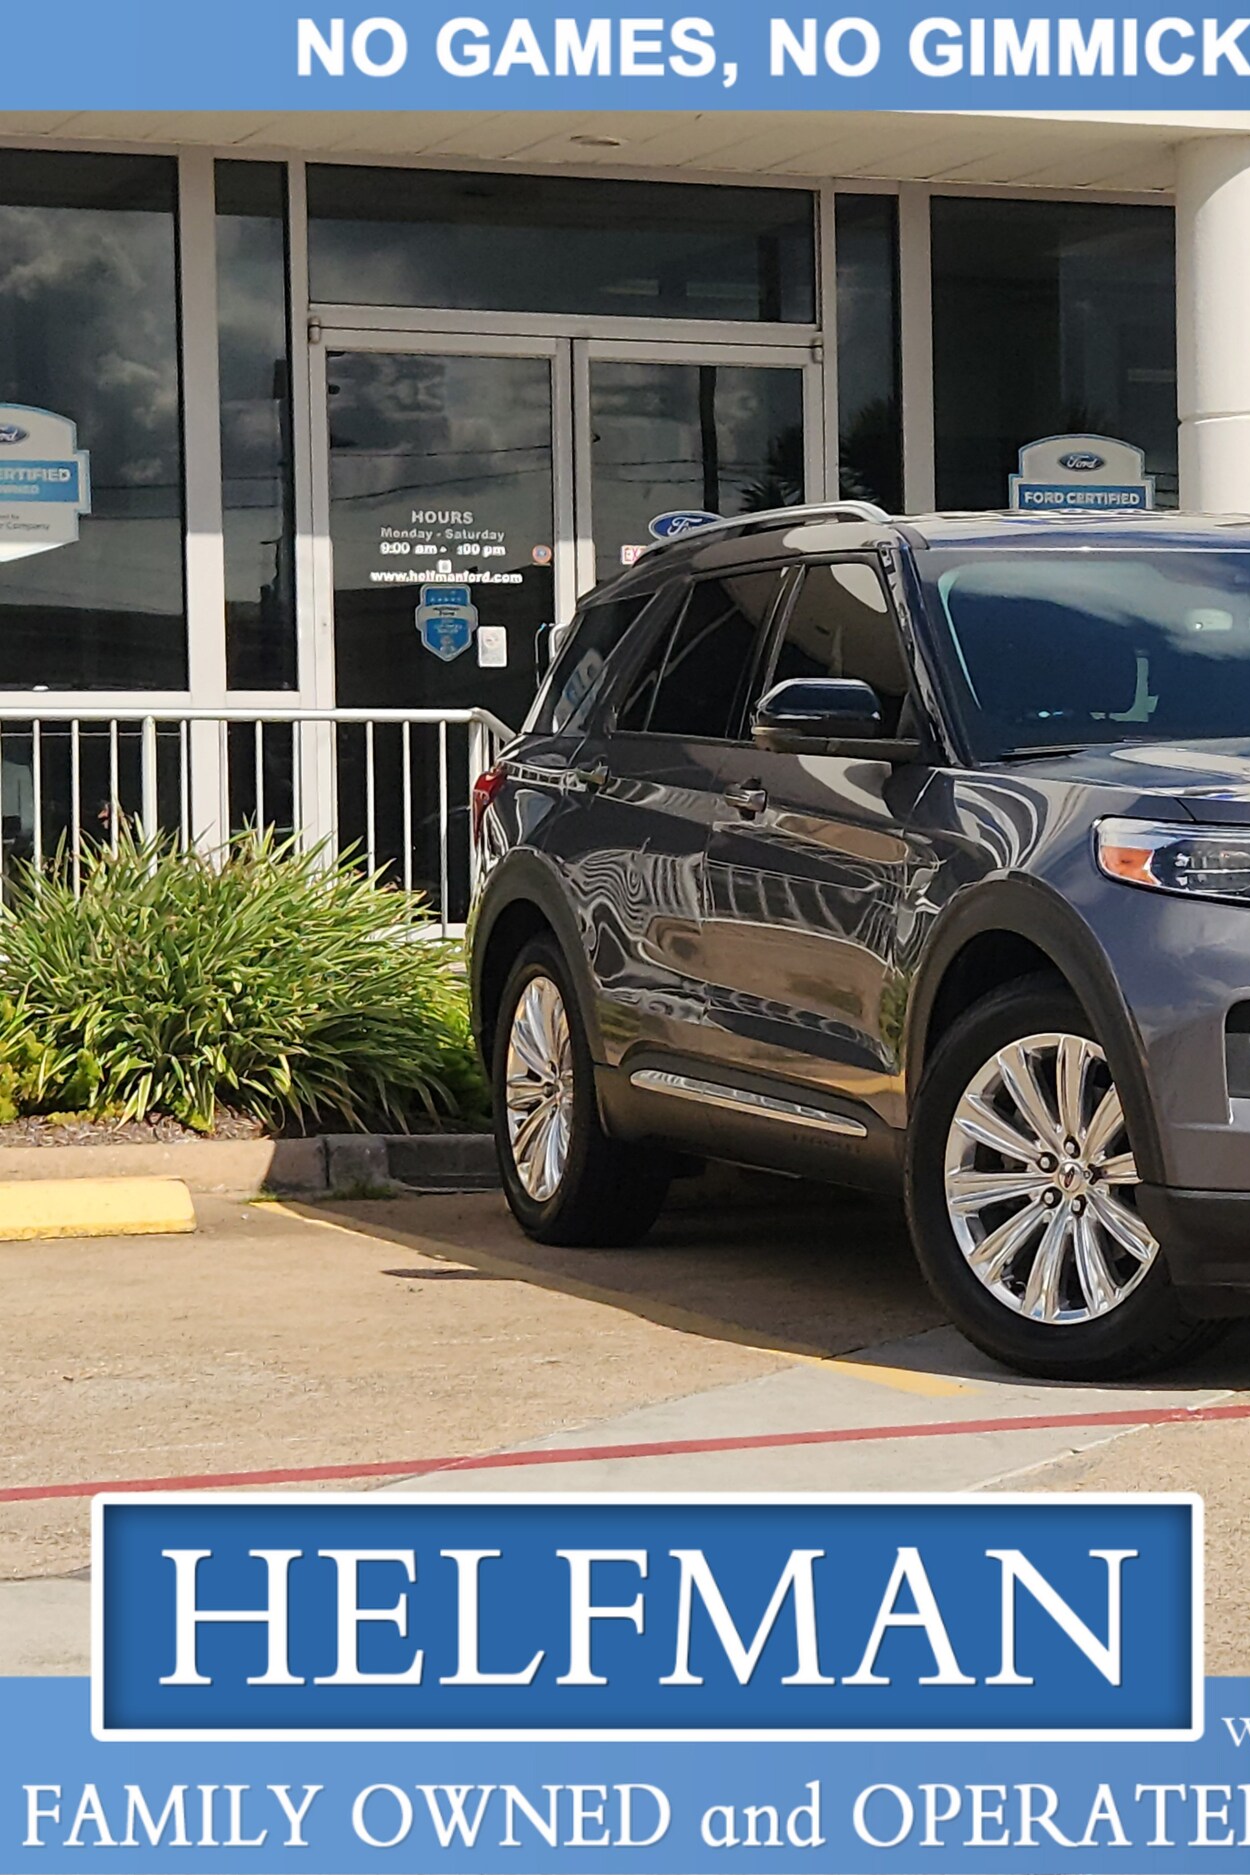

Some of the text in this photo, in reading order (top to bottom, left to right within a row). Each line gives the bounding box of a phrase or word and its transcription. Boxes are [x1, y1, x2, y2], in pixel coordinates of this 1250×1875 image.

[0, 468, 71, 482] ERTIFIED
[1024, 491, 1140, 505] FORD CERTIFIED
[411, 510, 474, 525] HOURS
[380, 527, 433, 542] Monday
[444, 528, 505, 543] Saturday
[379, 541, 411, 555] 9:00
[414, 543, 438, 555] am
[482, 544, 507, 558] pm
[370, 568, 524, 584] www.helfmanford.com
